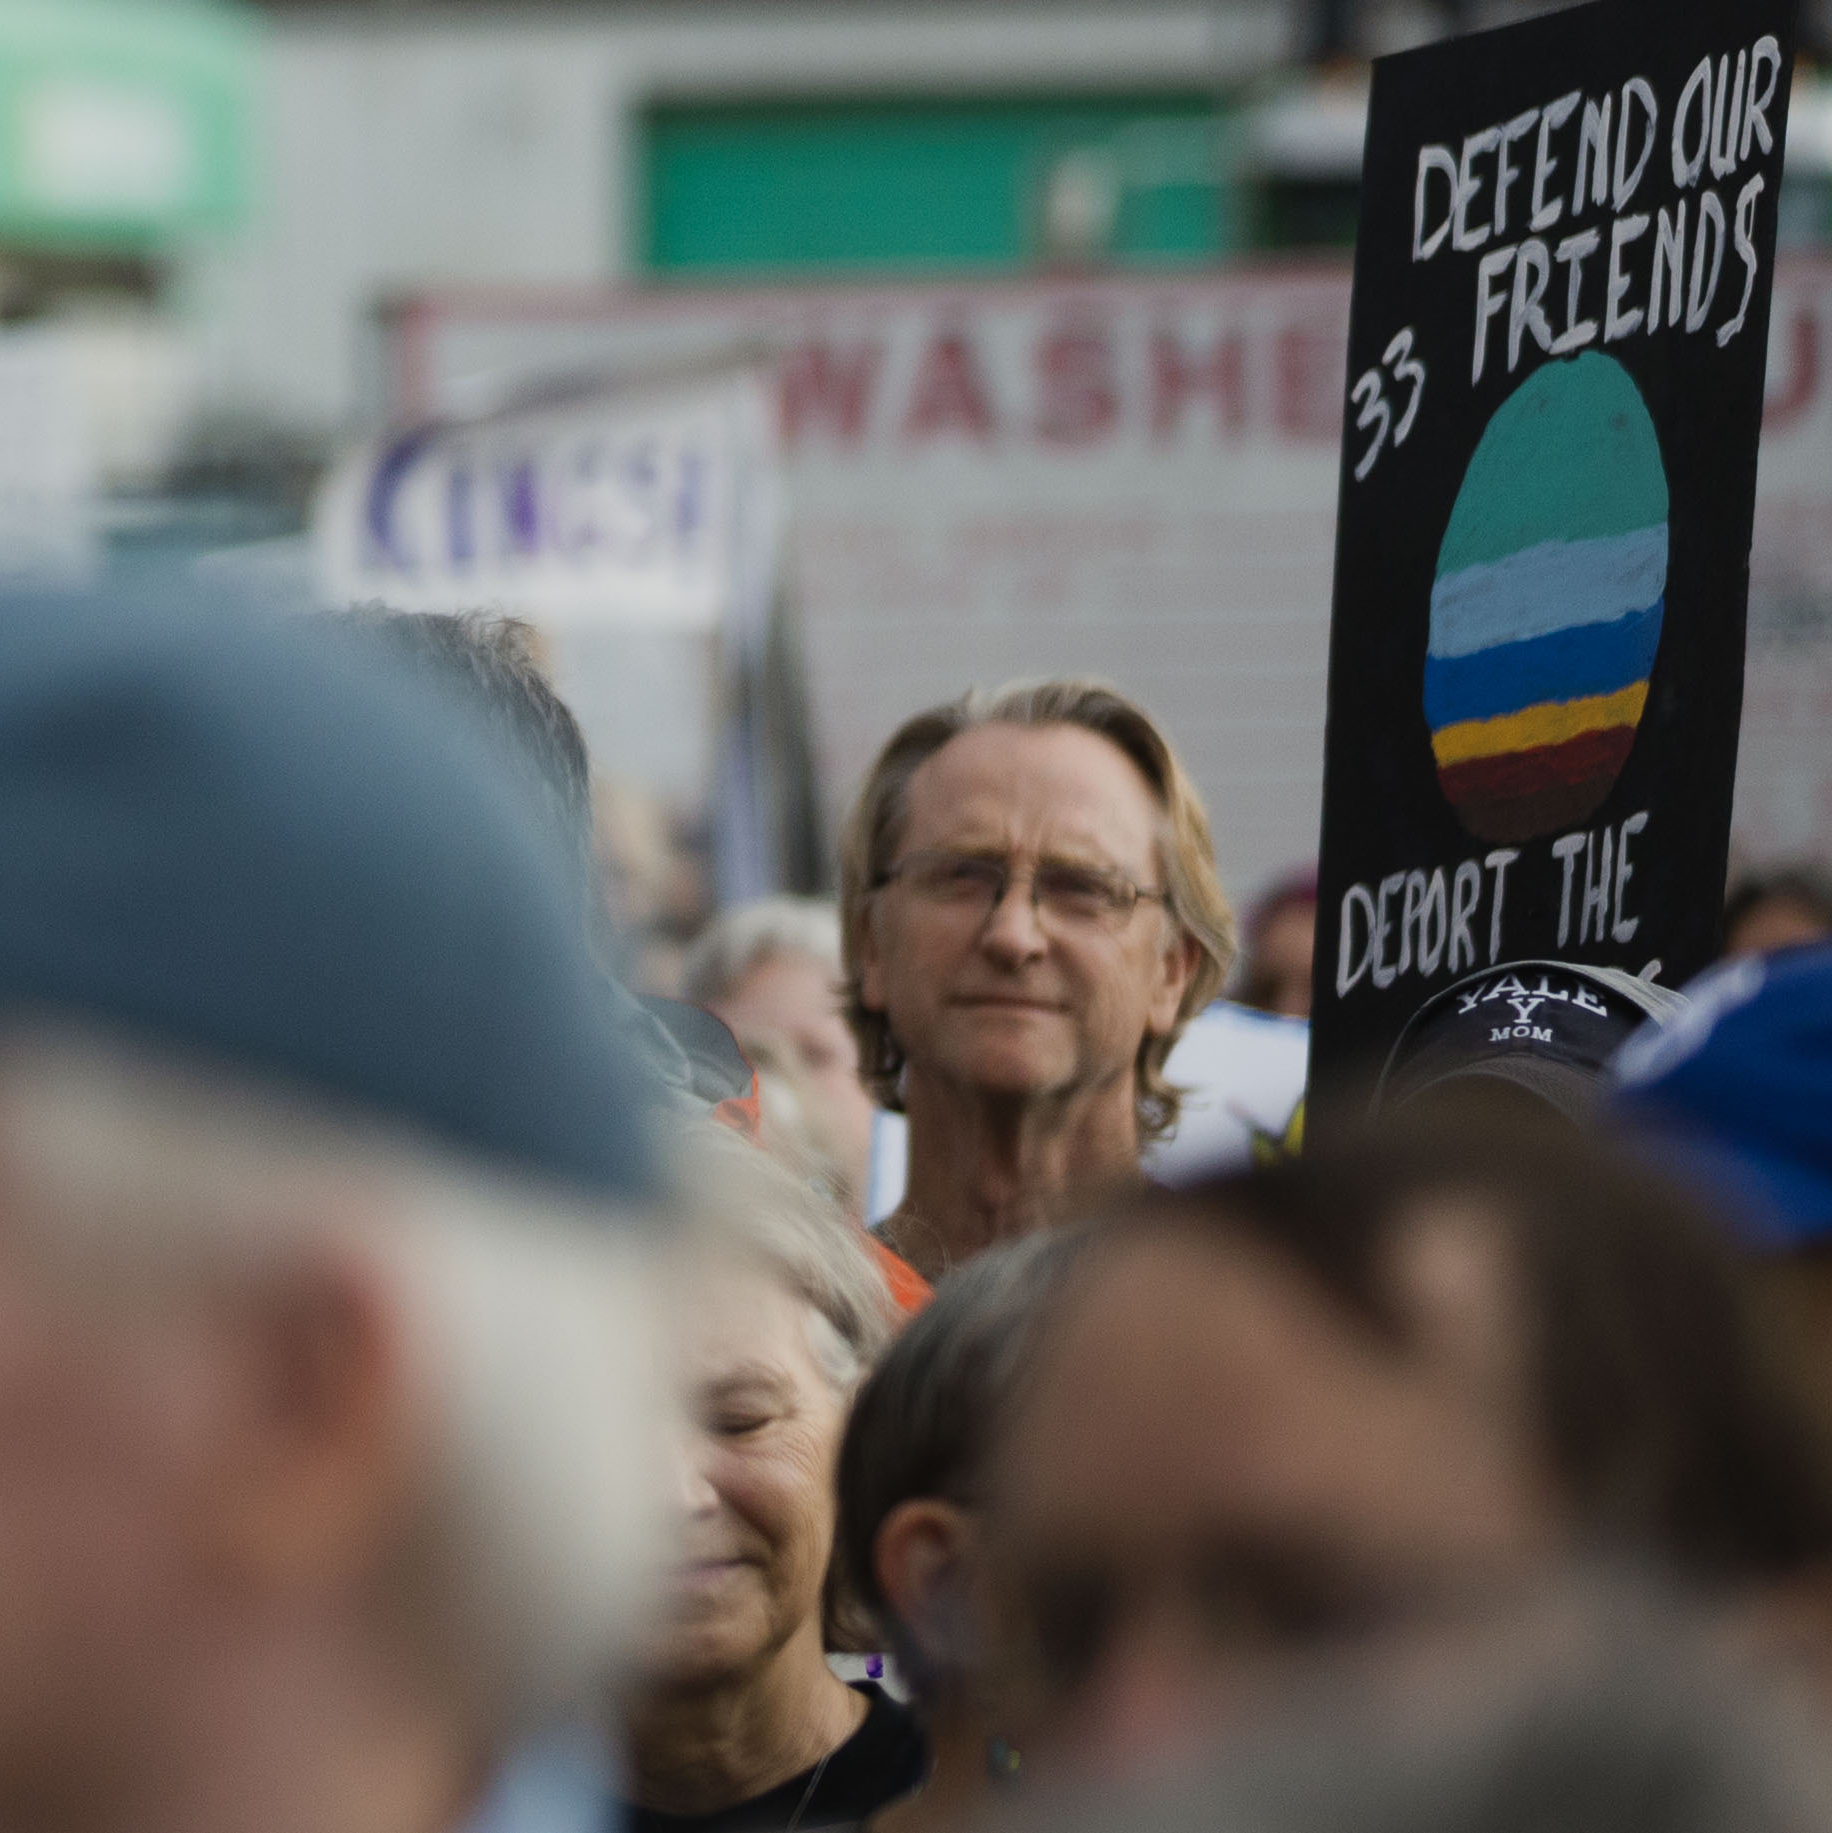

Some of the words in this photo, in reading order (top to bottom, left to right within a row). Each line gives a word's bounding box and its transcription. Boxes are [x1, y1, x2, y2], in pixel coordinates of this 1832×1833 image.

[1411, 76, 1657, 264] DEFEND
[1671, 33, 1782, 190] OUR
[1472, 171, 1766, 388] FRIENDS
[1334, 847, 1522, 999] DEPORT
[1551, 810, 1649, 950] THE
[1456, 973, 1609, 1018] YALE
[1488, 1025, 1554, 1044] MOM
[1506, 997, 1546, 1025] Y
